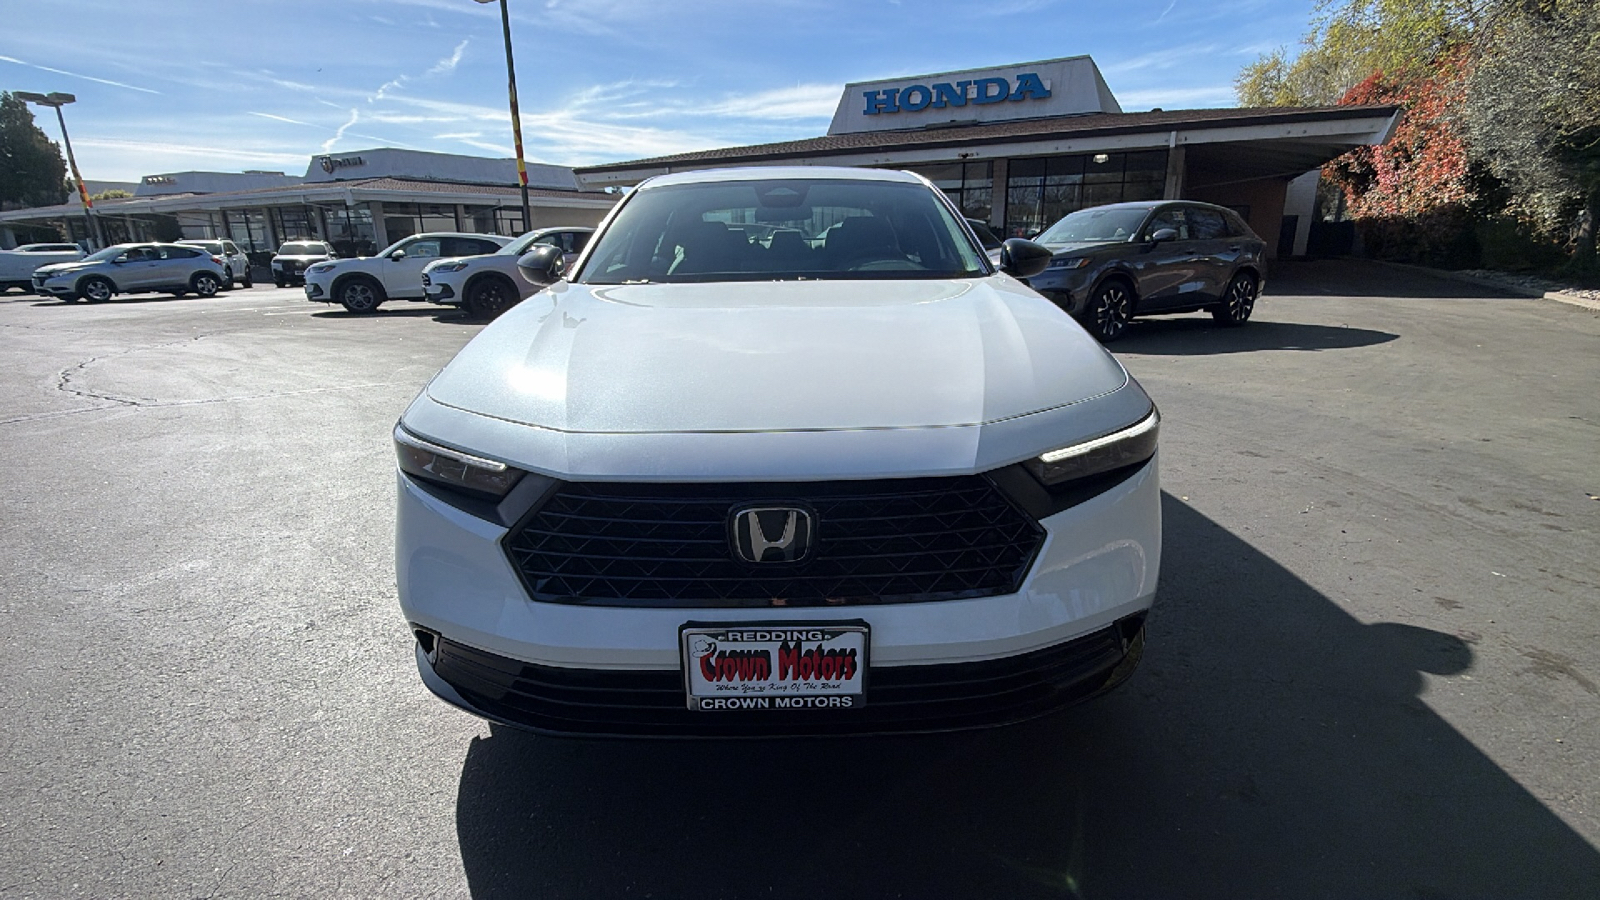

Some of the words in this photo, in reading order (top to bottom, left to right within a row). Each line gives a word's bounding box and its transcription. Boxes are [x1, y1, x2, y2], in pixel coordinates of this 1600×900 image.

[863, 73, 1052, 116] HONDA
[727, 631, 823, 641] REDDING
[699, 642, 772, 682] Crown
[778, 641, 858, 682] Motors
[768, 683, 788, 693] King
[790, 683, 801, 693] Of
[701, 698, 770, 710] CROWN
[775, 696, 854, 709] MOTORS
